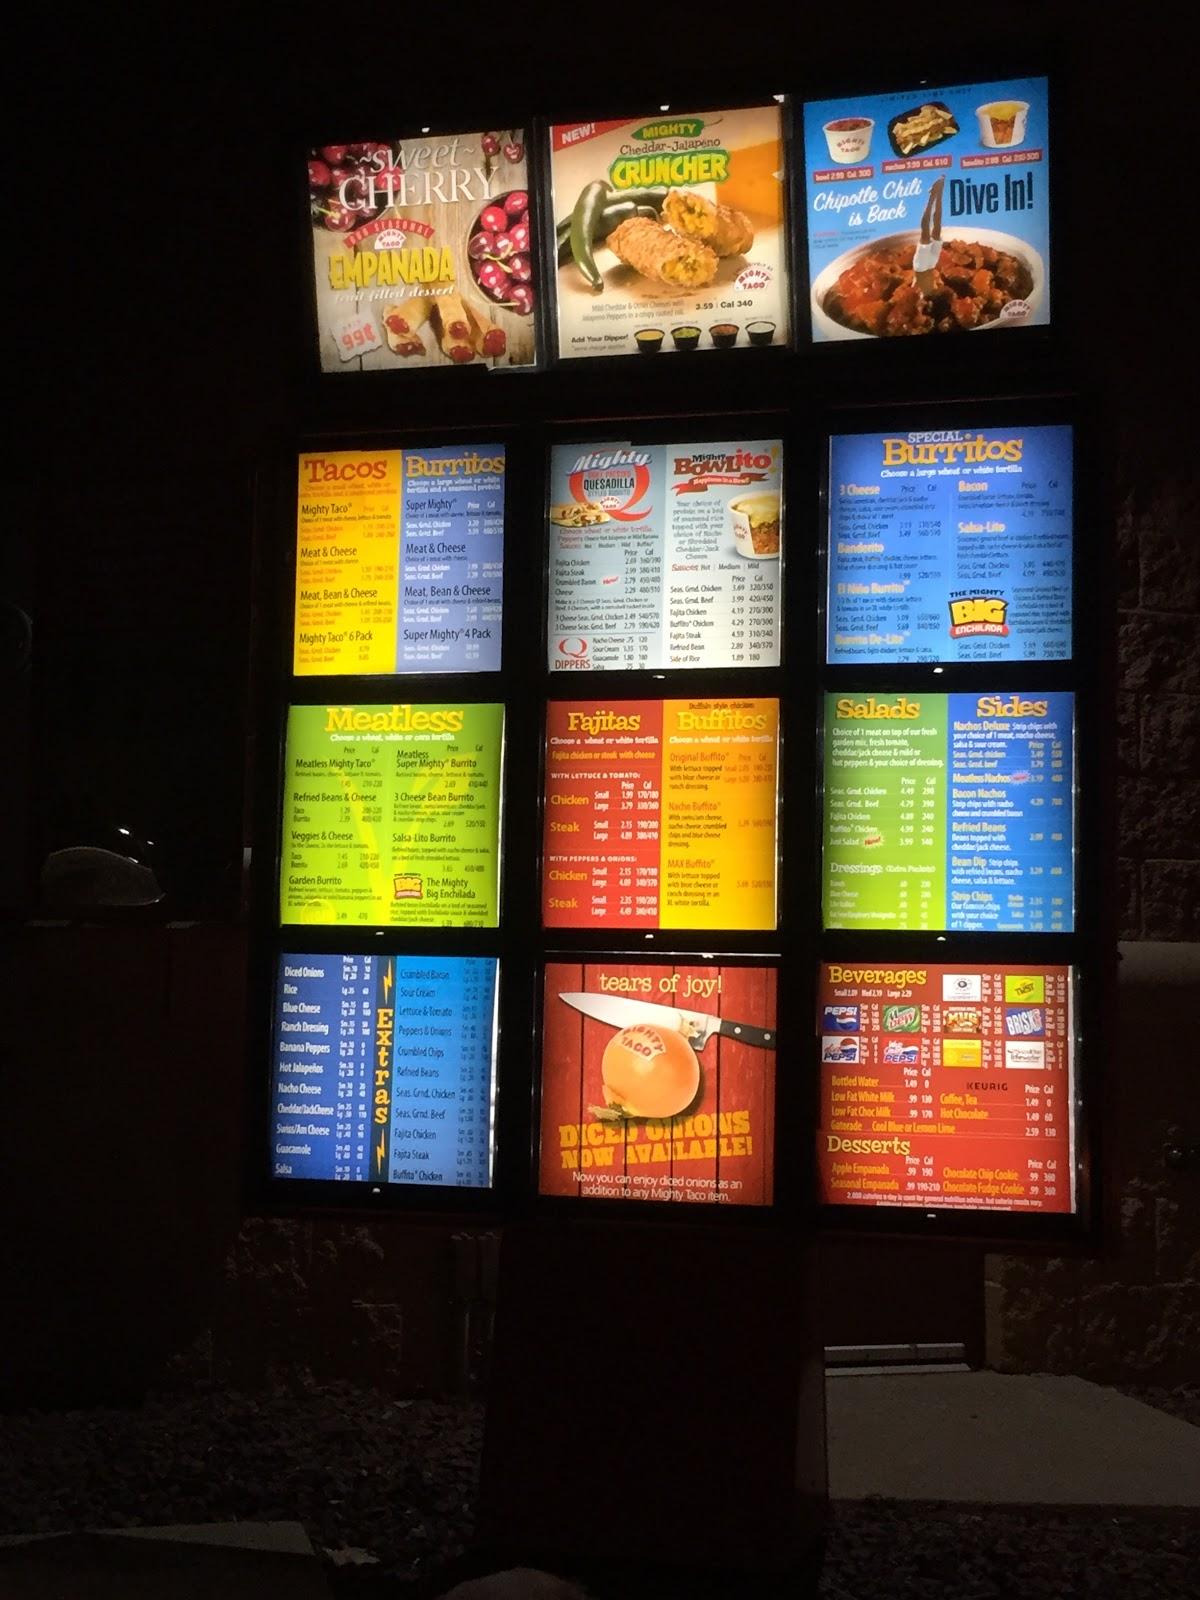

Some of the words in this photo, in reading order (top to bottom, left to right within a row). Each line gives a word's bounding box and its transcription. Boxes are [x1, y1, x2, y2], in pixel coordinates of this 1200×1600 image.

[561, 123, 596, 144] NEW!
[643, 123, 696, 138] MIGHTY
[614, 153, 728, 189] CRUNCHER
[339, 166, 498, 211] CHERRY
[950, 179, 998, 216] Dive
[1005, 172, 1033, 211] In!
[813, 186, 878, 213] Chipotle
[883, 178, 922, 200] Chili
[849, 212, 862, 226] is
[867, 200, 906, 223] Back
[328, 246, 455, 289] EMPANADA
[409, 284, 455, 297] dessert
[587, 334, 603, 343] Your
[908, 431, 964, 443] SPECIAL
[882, 434, 1023, 466] Burritos
[406, 452, 505, 477] Burritos
[566, 450, 652, 476] Mighty
[304, 459, 387, 483] Tacos
[881, 469, 908, 478] Choose
[916, 468, 936, 478] large
[973, 466, 994, 474] white
[995, 465, 1023, 473] tortilla
[584, 477, 634, 490] QUESADILLA
[302, 505, 329, 517] Mighty
[331, 504, 348, 513] Taco
[406, 500, 426, 512] Super
[428, 499, 452, 512] Mighty
[301, 548, 320, 557] Meat
[322, 547, 327, 557] &
[330, 546, 357, 556] Cheese
[406, 544, 427, 553] Meat
[429, 543, 435, 553] &
[437, 543, 465, 552] Cheese
[405, 587, 428, 597] Meat,
[431, 586, 451, 596] Bean
[453, 585, 459, 596] &
[462, 585, 491, 595] Cheese
[949, 597, 1008, 626] BIG
[300, 633, 326, 645] Mighty
[328, 632, 343, 641] Taco
[349, 632, 354, 640] 6
[356, 630, 373, 640] Pack
[404, 629, 428, 641] Super
[430, 629, 460, 642] Mighty
[465, 629, 470, 638] 4
[472, 628, 491, 638] Pack
[555, 660, 590, 669] DIPPERS
[836, 698, 921, 719] Salads
[977, 696, 1048, 717] Sides
[325, 704, 464, 732] Meatless
[568, 711, 641, 735] Fajitas
[397, 750, 429, 758] Meatless
[296, 759, 327, 768] Meatless
[329, 759, 354, 770] Mighty
[356, 759, 371, 767] Taco
[551, 822, 580, 832] Steak
[549, 870, 588, 880] Chicken
[831, 862, 882, 875] Dressings
[427, 878, 440, 887] The
[442, 878, 468, 888] Mighty
[427, 890, 438, 900] Big
[440, 889, 475, 898] Enchilada
[285, 967, 302, 977] Diced
[303, 967, 324, 977] Onions
[829, 966, 927, 988] Beverages
[284, 984, 298, 994] Rice
[600, 974, 652, 992] tears
[659, 973, 680, 992] of
[683, 975, 722, 997] joy!
[283, 1003, 298, 1012] Blue
[299, 1003, 320, 1013] Cheese
[824, 1007, 857, 1015] PEPSI
[282, 1022, 300, 1031] Ranch
[302, 1022, 329, 1035] Dressing
[1006, 1008, 1042, 1036] BRISK
[280, 1042, 304, 1052] Banana
[306, 1042, 330, 1054] Peppers
[622, 1037, 652, 1057] TACO
[824, 1053, 856, 1061] PEPSI
[885, 1054, 917, 1062] PEPSI
[375, 1008, 393, 1124] Extras
[904, 1068, 918, 1076] Price
[922, 1068, 931, 1076] Cal
[278, 1083, 299, 1093] Nacho
[300, 1084, 321, 1094] Cheese
[559, 1118, 638, 1147] DICED
[645, 1110, 750, 1139] ONIONS
[276, 1144, 311, 1154] Guacamole
[562, 1148, 614, 1168] NOW
[623, 1136, 752, 1164] AVAILABLE!
[827, 1136, 911, 1155] Desserts
[275, 1164, 292, 1174] Salsa
[572, 1172, 596, 1182] Now
[597, 1174, 614, 1185] you
[615, 1176, 632, 1184] can
[634, 1176, 658, 1186] enjoy
[660, 1175, 683, 1186] diced
[686, 1178, 716, 1188] onions
[718, 1180, 728, 1188] as
[730, 1181, 742, 1189] an
[583, 1185, 620, 1196] addition
[622, 1187, 632, 1196] to
[633, 1189, 649, 1199] any
[652, 1189, 683, 1201] Mighty
[686, 1190, 705, 1200] Taco
[708, 1190, 728, 1201] item.
